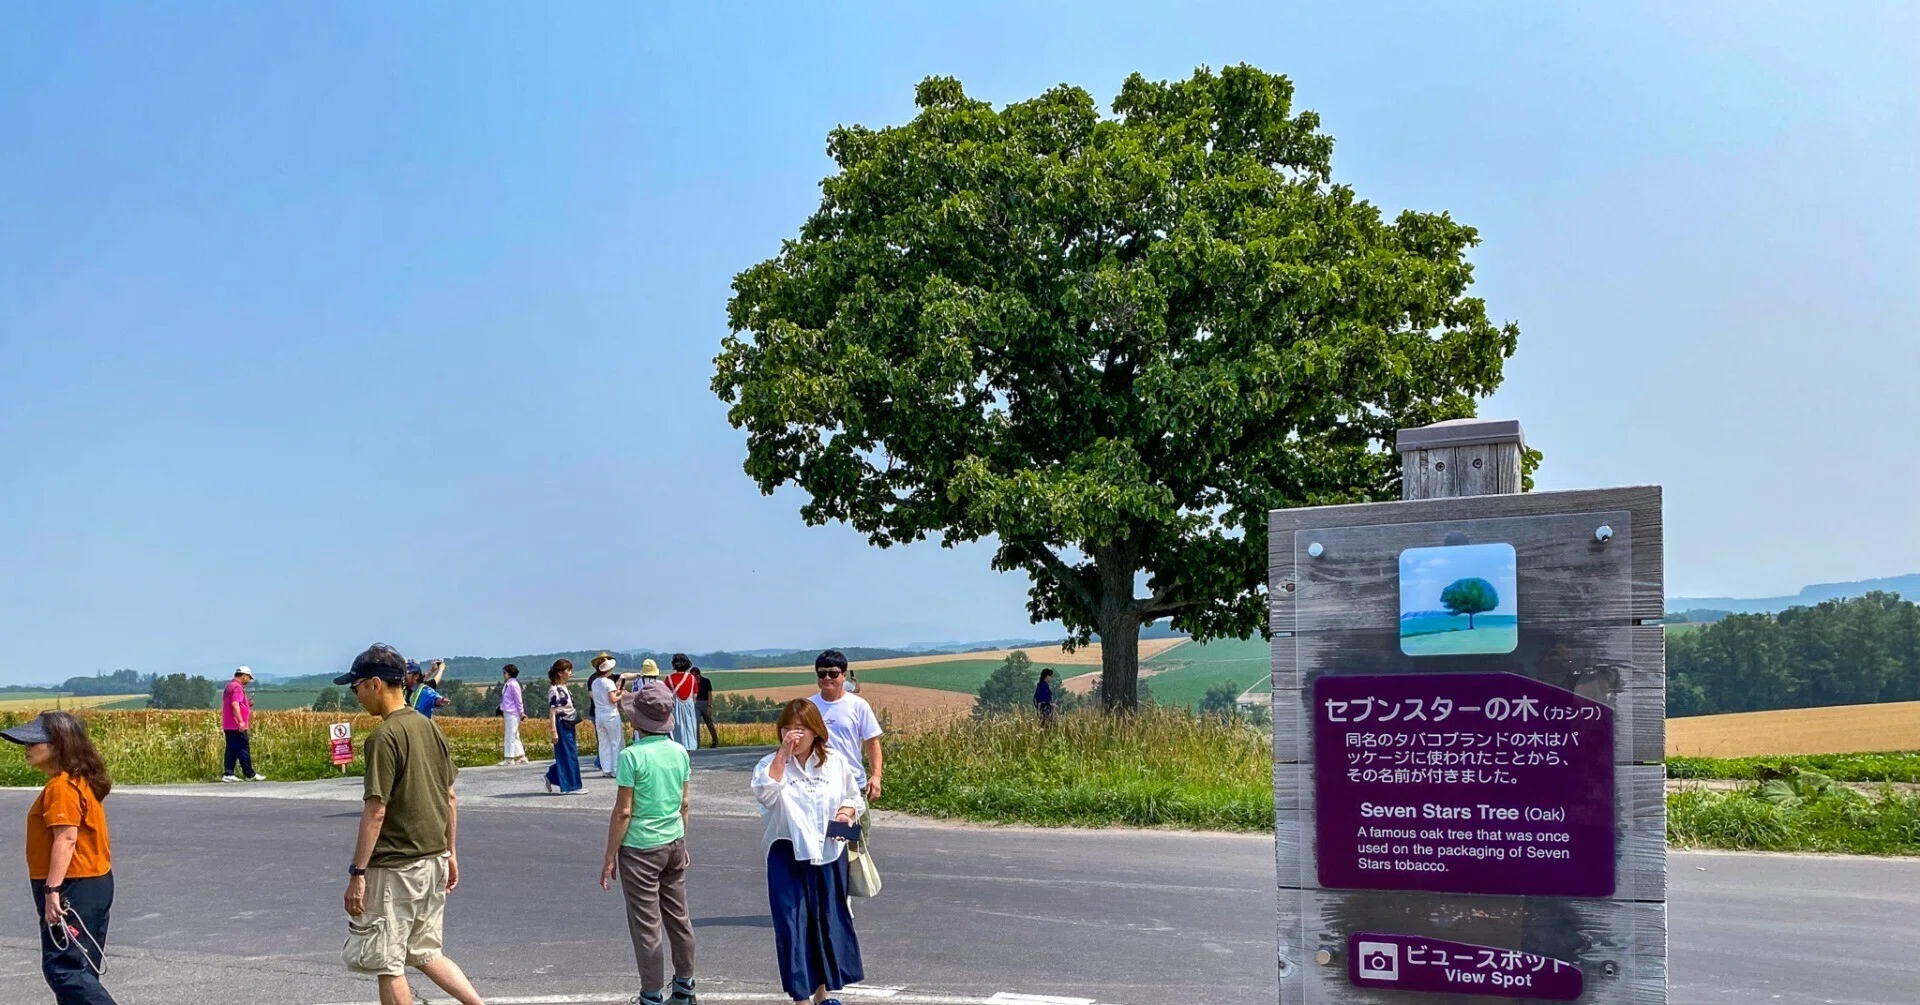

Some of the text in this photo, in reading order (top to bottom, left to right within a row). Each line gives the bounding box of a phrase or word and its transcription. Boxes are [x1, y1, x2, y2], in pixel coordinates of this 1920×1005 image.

[1346, 731, 1579, 747] 同名のタバコブランドの木はパ
[1347, 750, 1568, 766] ッケージに使われたことから、
[1346, 768, 1518, 784] その名前が付きました。
[1360, 802, 1565, 822] Seven Stars Tree (Oak)
[1357, 826, 1570, 842] A famous oak tree that was once
[1357, 842, 1570, 860] used on the packaging of Seven
[1358, 857, 1449, 872] Stars tobacco.
[1407, 945, 1570, 973] ビュースポット
[1444, 968, 1532, 988] View Spot
